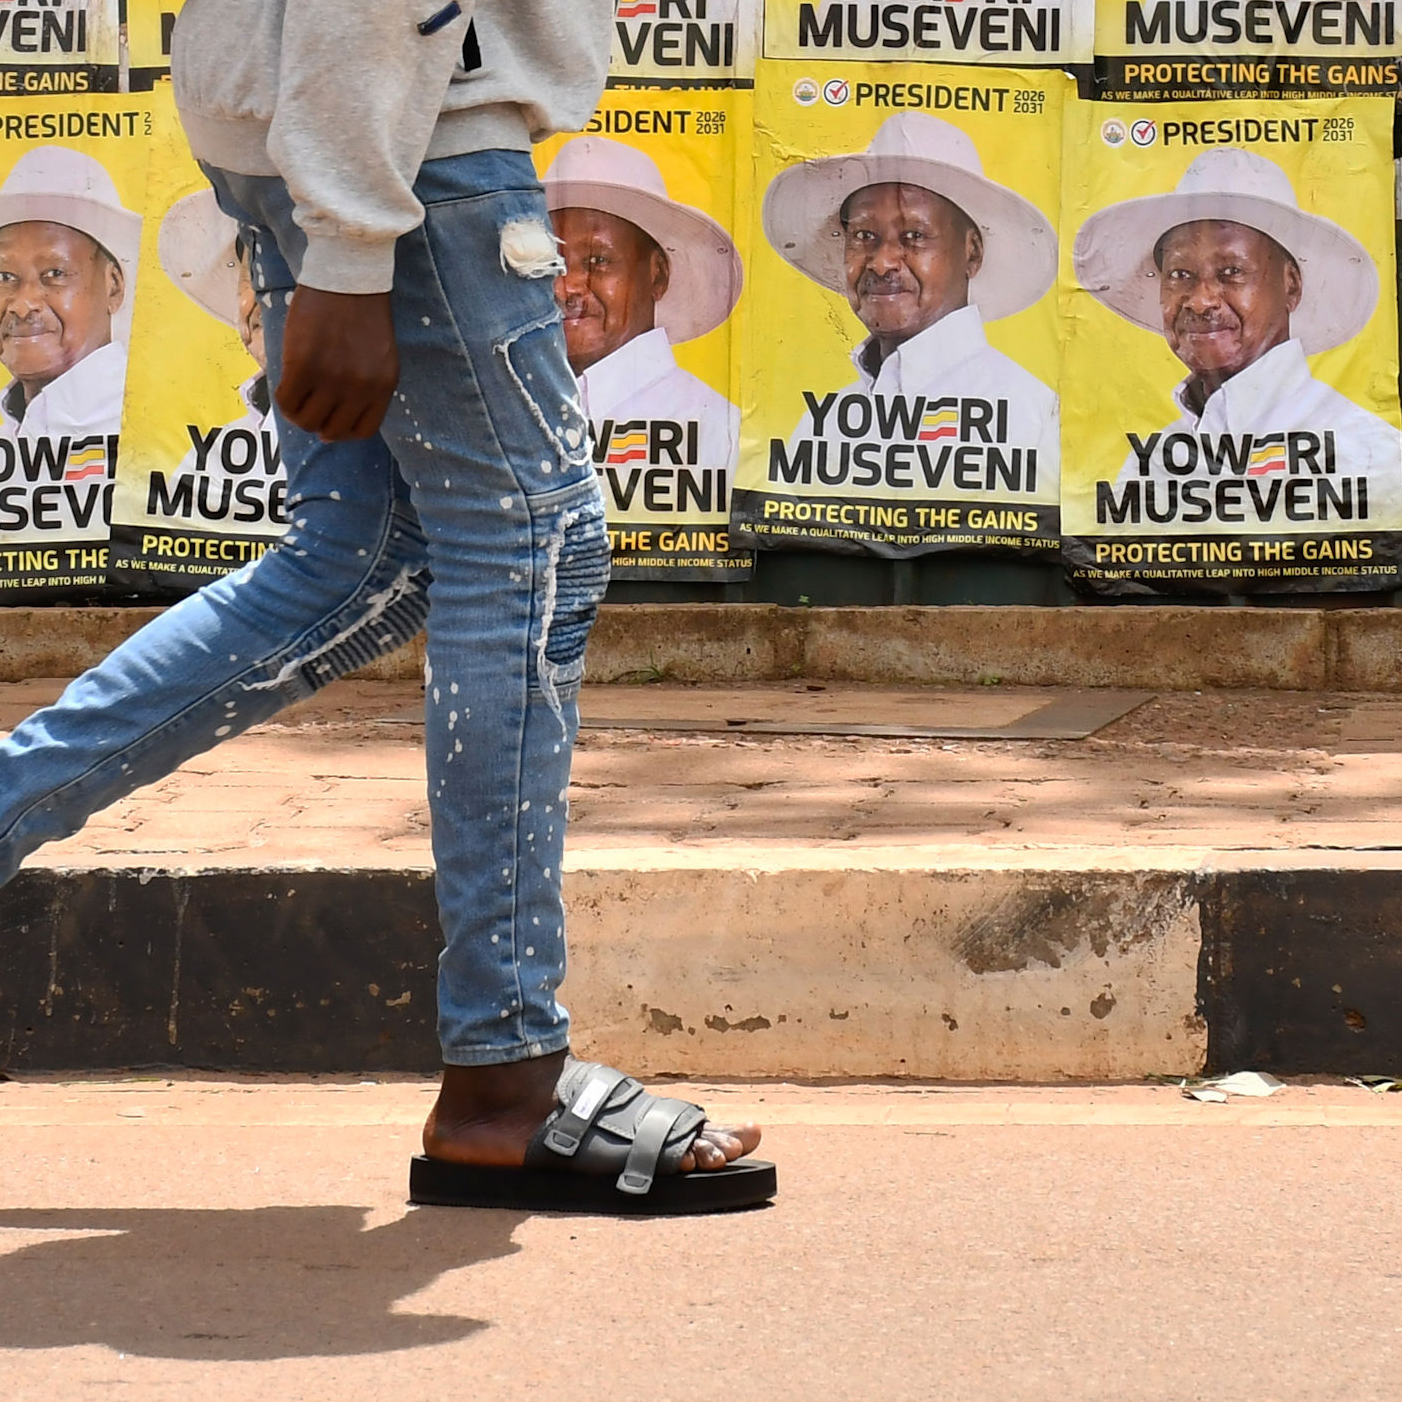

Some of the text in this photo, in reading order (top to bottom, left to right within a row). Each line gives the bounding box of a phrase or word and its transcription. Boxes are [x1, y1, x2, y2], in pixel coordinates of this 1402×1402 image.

[1125, 0, 1394, 46] MUSEVENI
[1163, 119, 1318, 145] PRESIDENT
[1322, 130, 1354, 142] 2031
[1323, 118, 1354, 130] 2026
[802, 390, 1008, 442] YOWERI
[768, 438, 1038, 493] MUSEVENI
[1127, 430, 1336, 476] YOWERI
[1097, 478, 1368, 525] MUSEVENI
[1096, 539, 1373, 564] PROTECTING THE GAINS
[1073, 570, 1085, 578] AS
[1088, 570, 1103, 578] WE
[1105, 570, 1131, 578] MAKE
[1143, 570, 1203, 578] QUALITATIVE
[1206, 569, 1230, 577] LEAP
[1233, 569, 1255, 577] INTO
[1258, 568, 1280, 576] HIGH
[1283, 567, 1320, 576] MIDDLE
[1322, 567, 1359, 575] INCOME
[1361, 566, 1397, 574] STATUS
